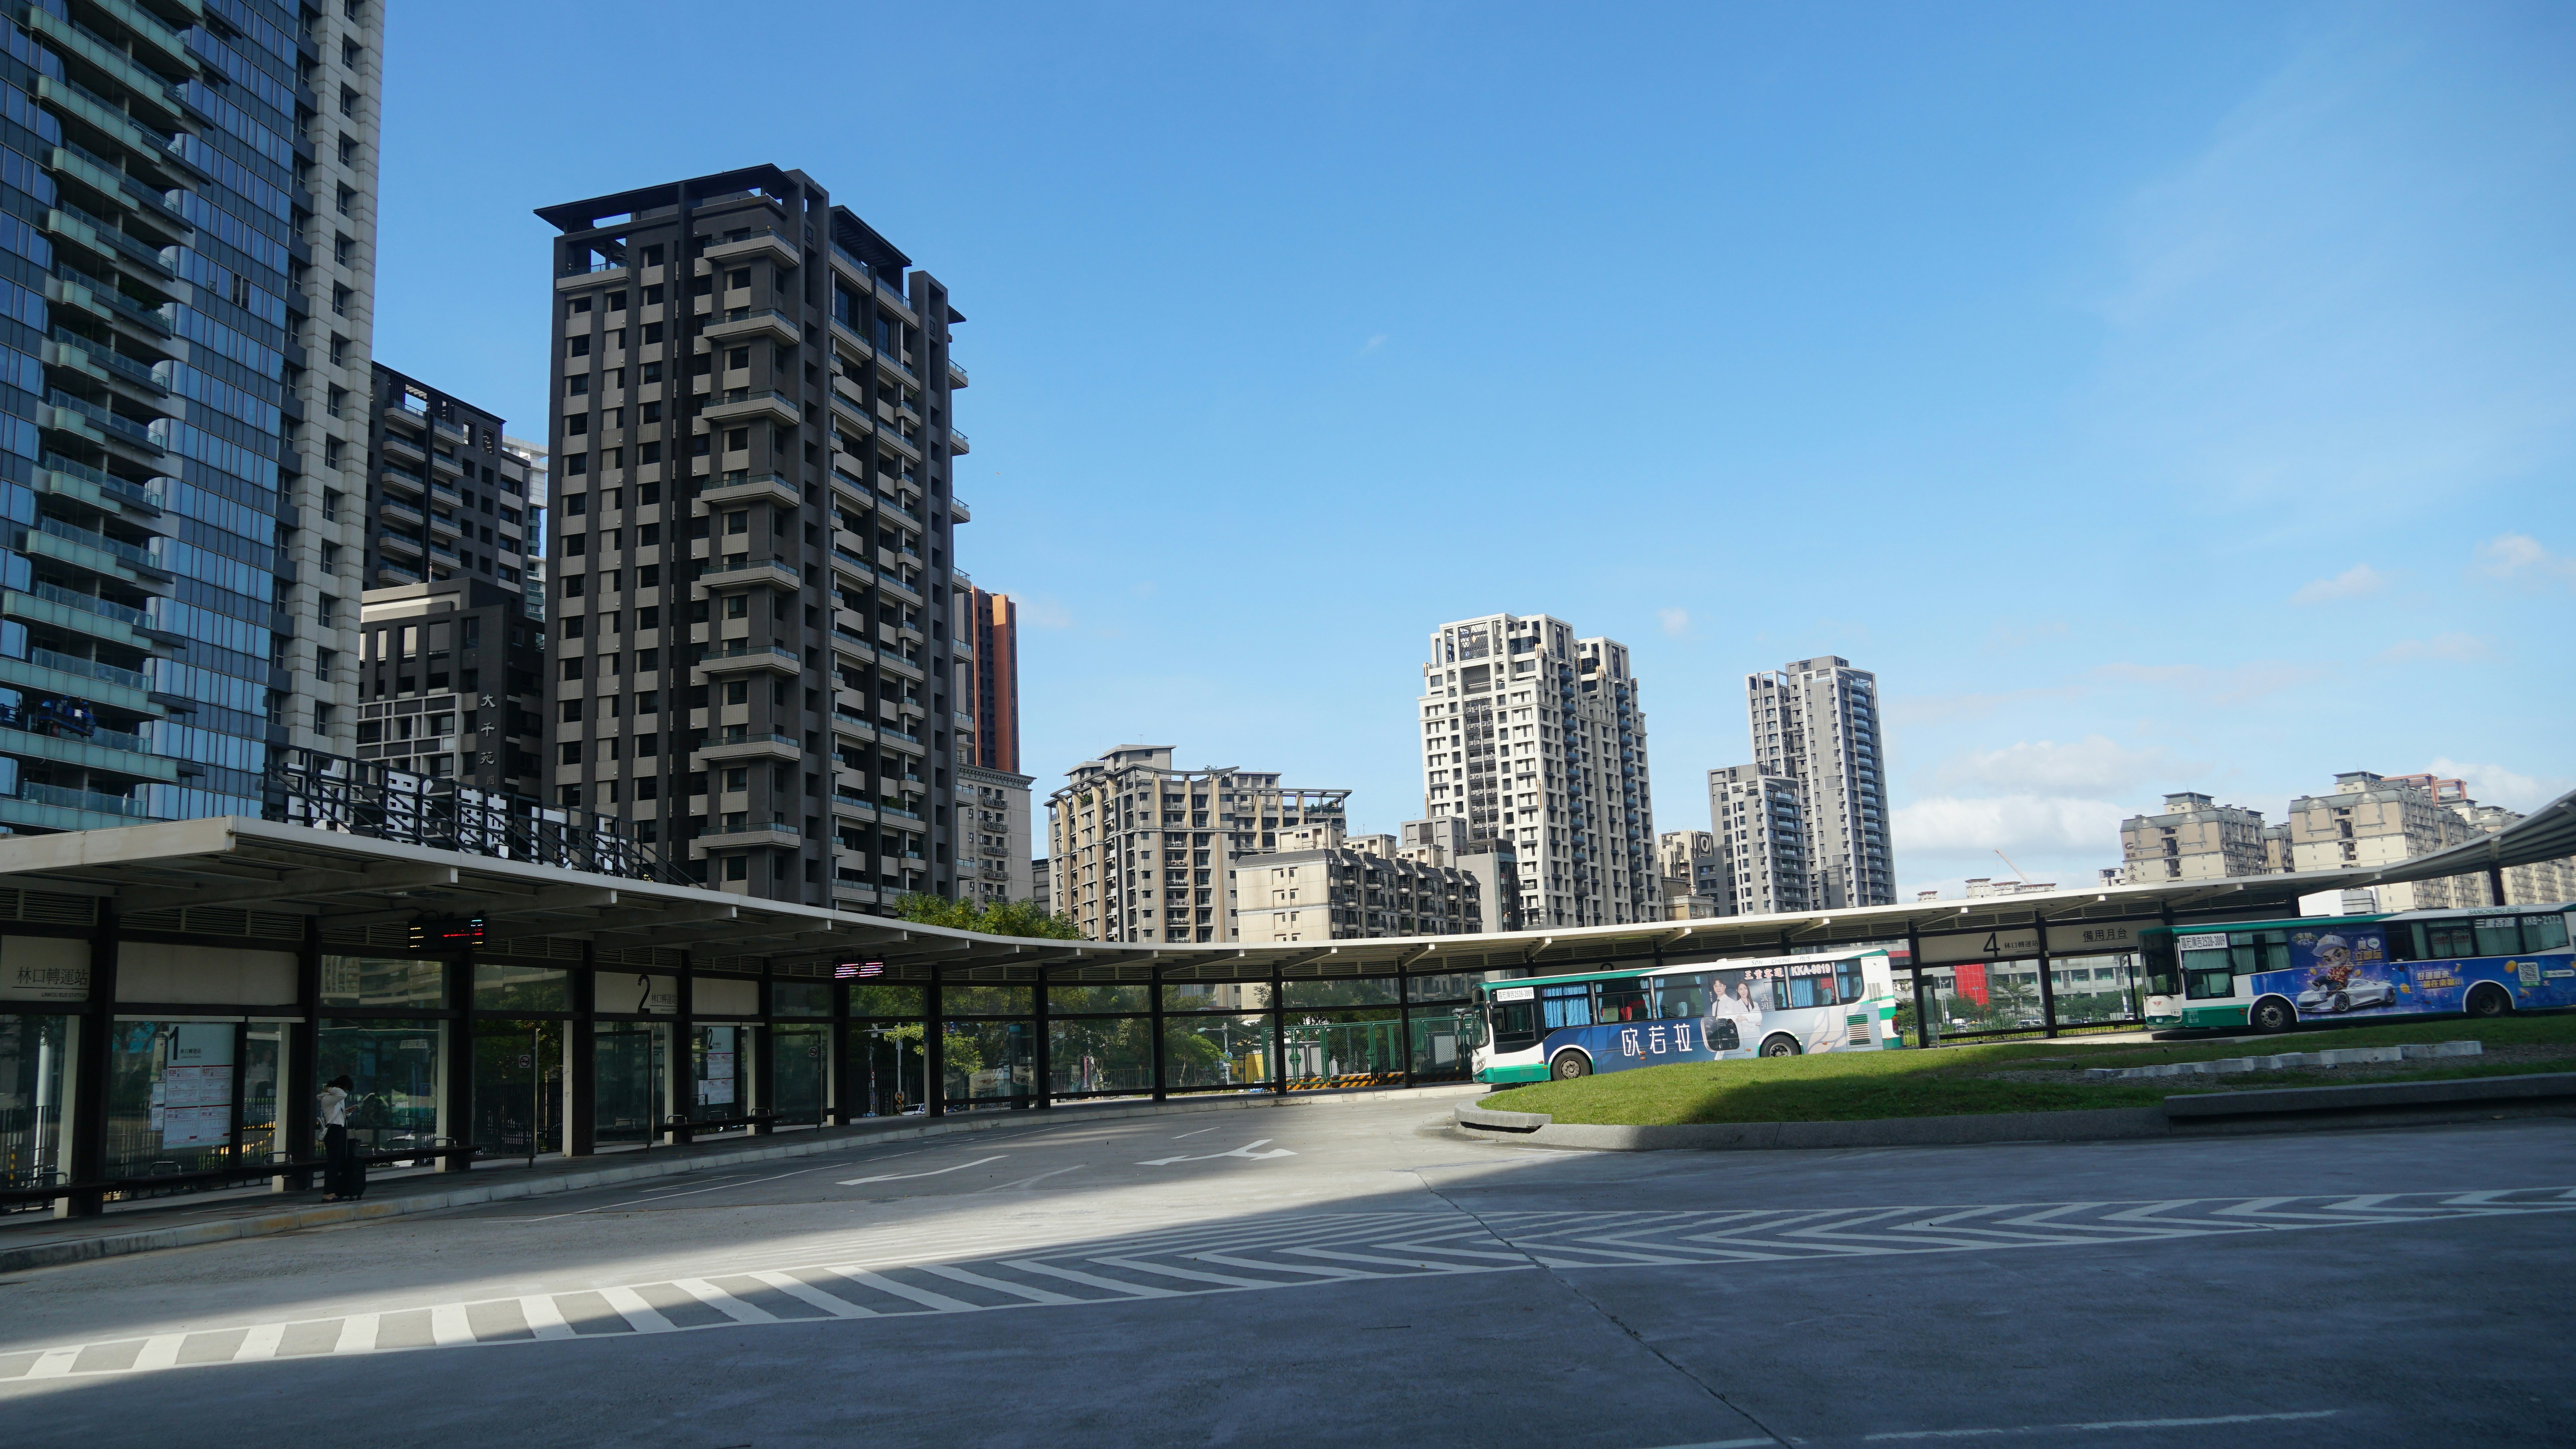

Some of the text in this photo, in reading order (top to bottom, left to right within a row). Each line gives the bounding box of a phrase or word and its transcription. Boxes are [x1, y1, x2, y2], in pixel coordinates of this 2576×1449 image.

[2522, 915, 2562, 926] KKB-2173
[2083, 927, 2127, 942] 備用月台
[1983, 932, 2001, 957] 4
[2004, 940, 2039, 949] 林口轉運站
[17, 967, 88, 986] 林口轉運站
[1744, 967, 1784, 980] 三重客運
[1791, 963, 1831, 976] KKA-9819
[637, 974, 650, 1014] 2
[651, 993, 677, 1004] 林口轉運站
[169, 1026, 179, 1060] 1
[708, 1028, 713, 1050] 2
